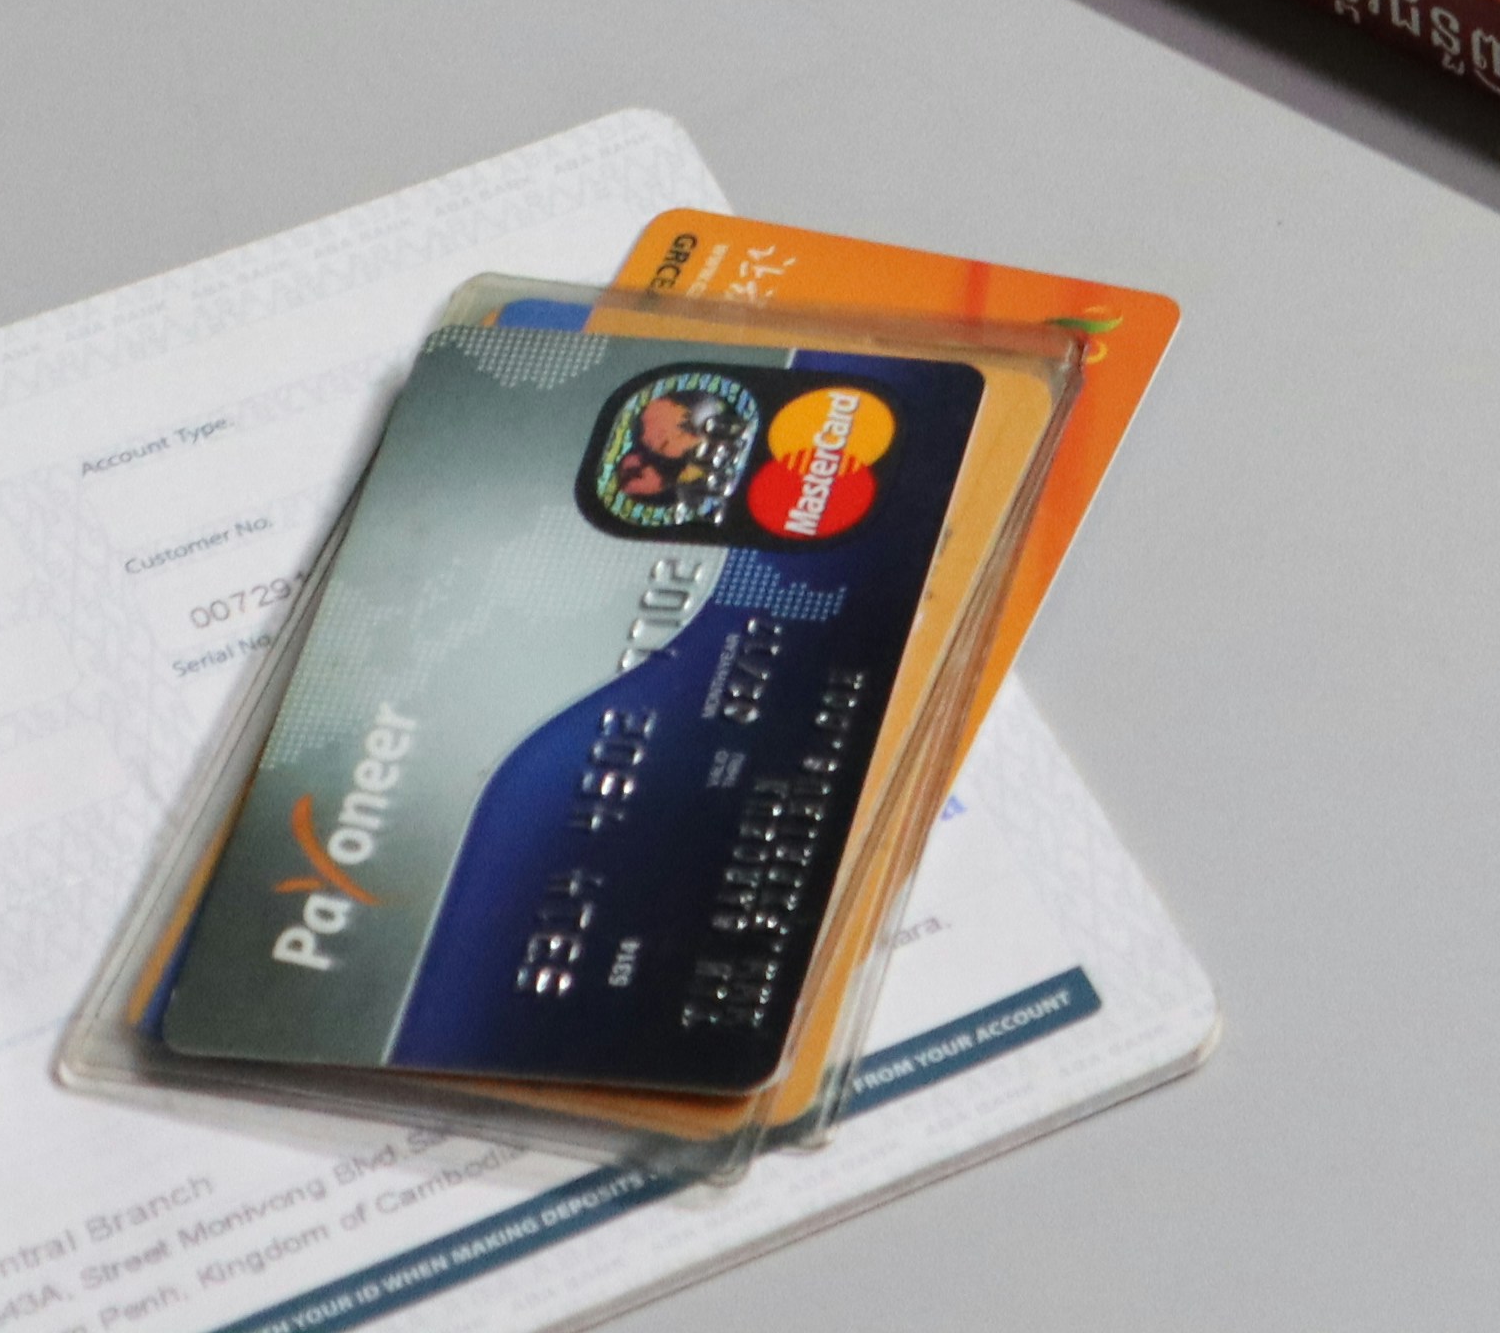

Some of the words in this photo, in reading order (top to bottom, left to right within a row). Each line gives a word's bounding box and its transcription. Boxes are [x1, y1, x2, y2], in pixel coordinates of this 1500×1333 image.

[78, 433, 171, 478] Account
[784, 388, 862, 538] MasterCard
[122, 527, 232, 577] Customer
[233, 512, 275, 540] No.
[170, 642, 236, 678] Serial
[271, 695, 420, 973] Payoneer
[608, 937, 640, 988] 5314
[295, 1285, 354, 1327] YOUR
[382, 1253, 449, 1296] WHEN
[450, 1216, 541, 1264] MAKING
[543, 1172, 646, 1229] DEPOSITS
[851, 1056, 913, 1094] FROM
[914, 1033, 975, 1071] YOUR
[975, 990, 1071, 1046] ACCOUNT
[78, 1241, 172, 1292] Street
[177, 1179, 328, 1252] Monivong
[86, 1169, 213, 1241] Branch
[97, 1285, 188, 1332] Penh,
[198, 1221, 330, 1295] Kingdom
[339, 1201, 368, 1233] of
[374, 1141, 527, 1218] Cambodia
